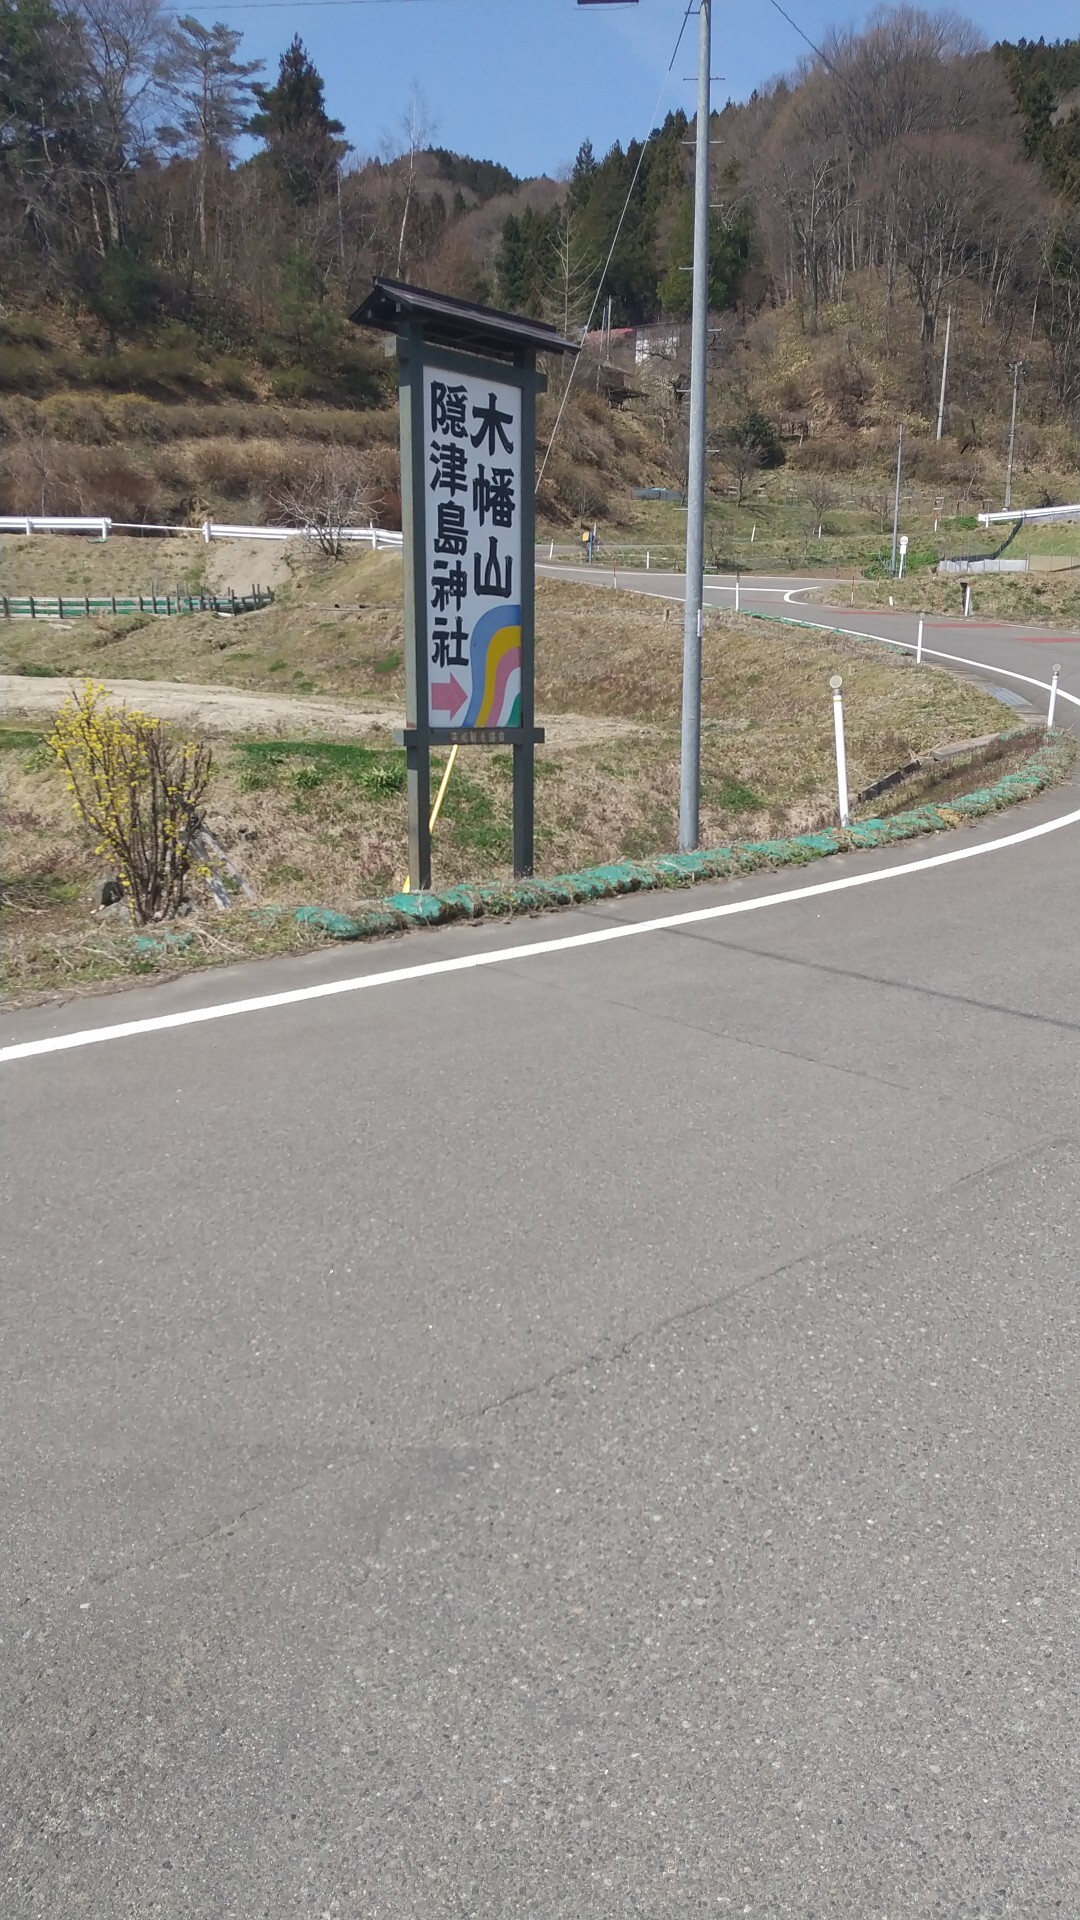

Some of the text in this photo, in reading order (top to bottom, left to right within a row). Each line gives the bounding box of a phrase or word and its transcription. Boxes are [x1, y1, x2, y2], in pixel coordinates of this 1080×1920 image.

[430, 380, 469, 668] 隠津島神社
[470, 392, 515, 598] 木幡山
